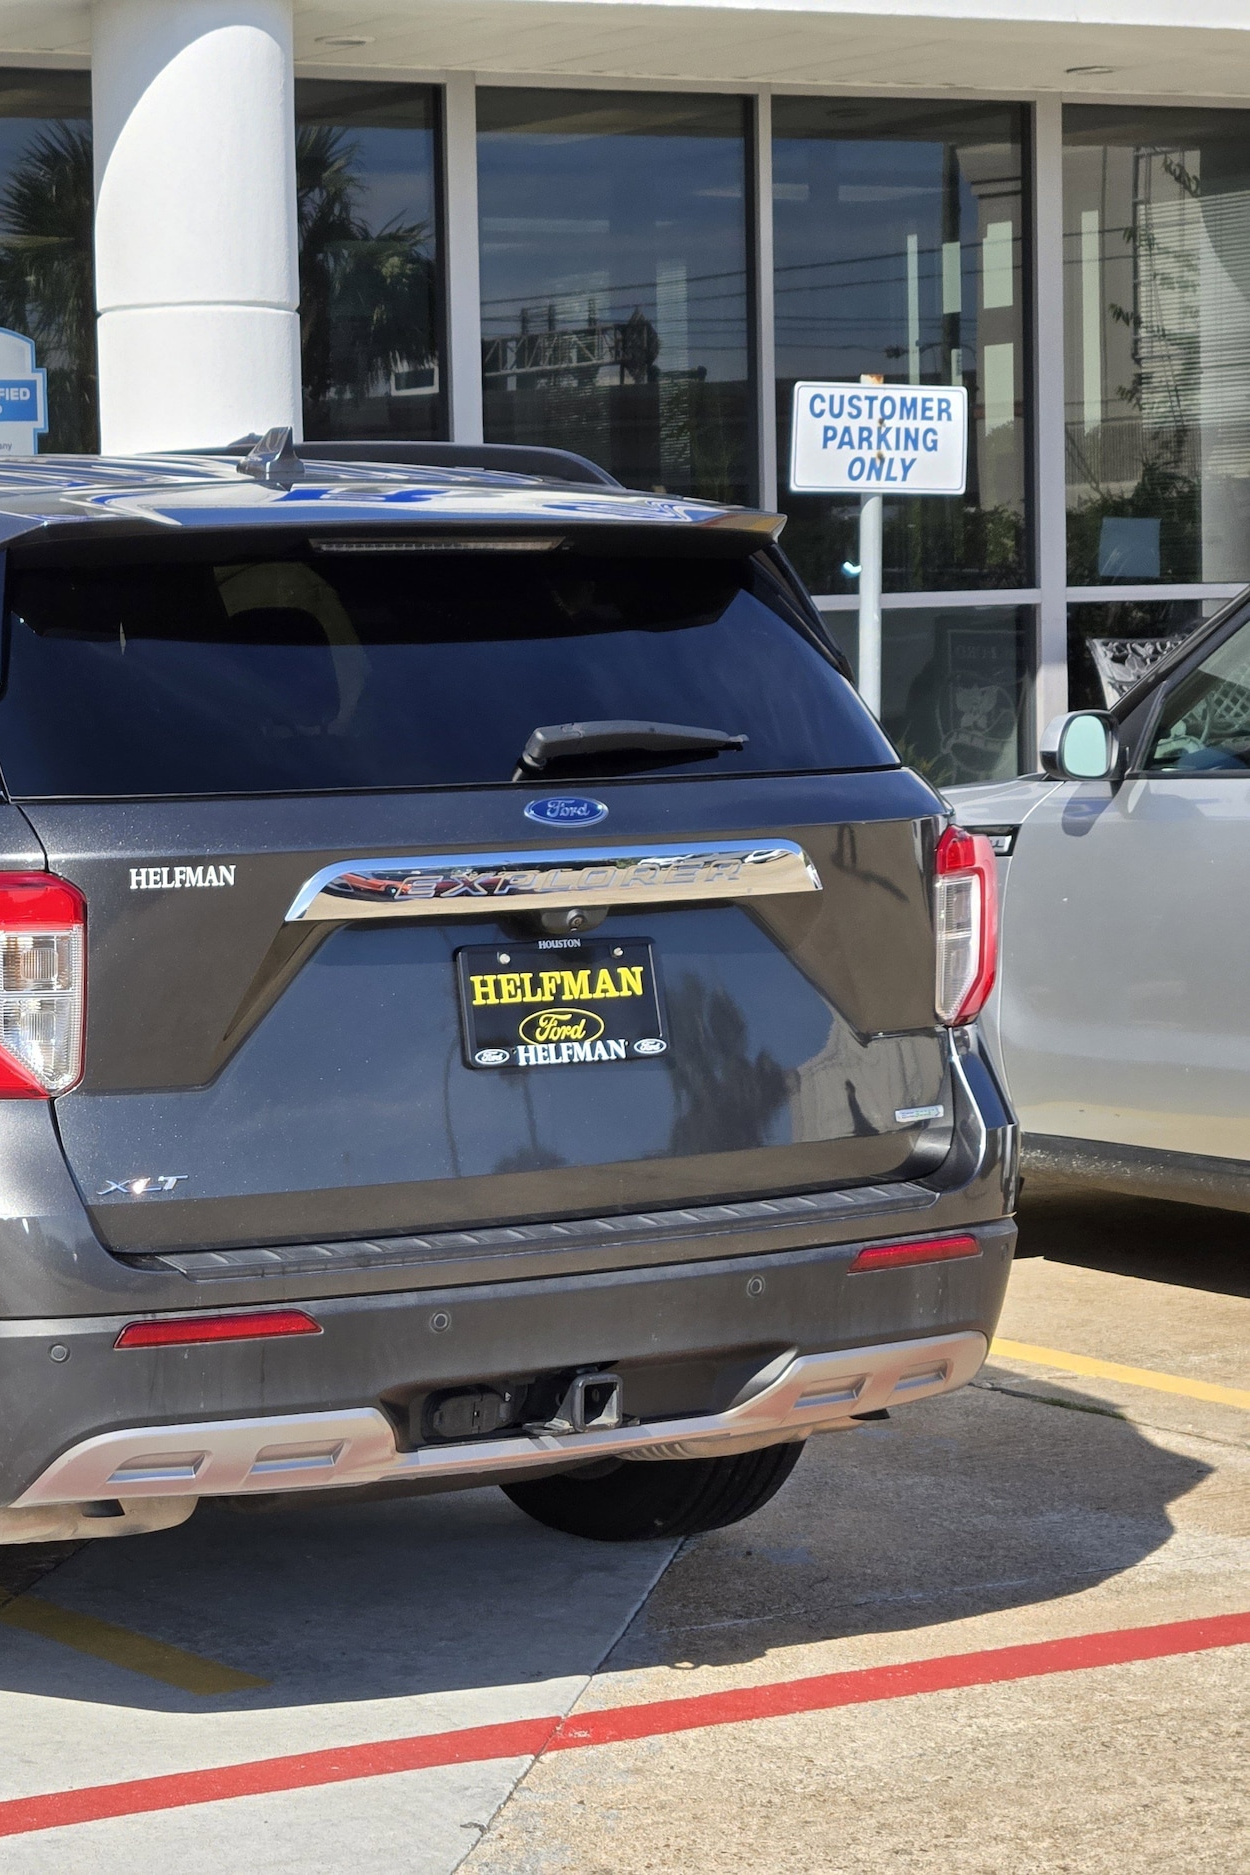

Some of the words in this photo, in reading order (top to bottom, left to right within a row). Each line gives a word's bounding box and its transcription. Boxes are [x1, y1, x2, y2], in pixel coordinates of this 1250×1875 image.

[809, 393, 953, 422] CUSTOMER
[822, 425, 938, 452] PARKING
[847, 456, 918, 482] ONLY
[546, 799, 591, 818] Ford
[129, 864, 237, 889] HELFMAN
[394, 858, 744, 900] EXPLORER
[538, 938, 581, 949] HOUSTON
[470, 966, 644, 1006] HELFMAN
[534, 1012, 587, 1042] Ford
[516, 1039, 628, 1067] HELFMAN
[96, 1175, 188, 1195] XLT
